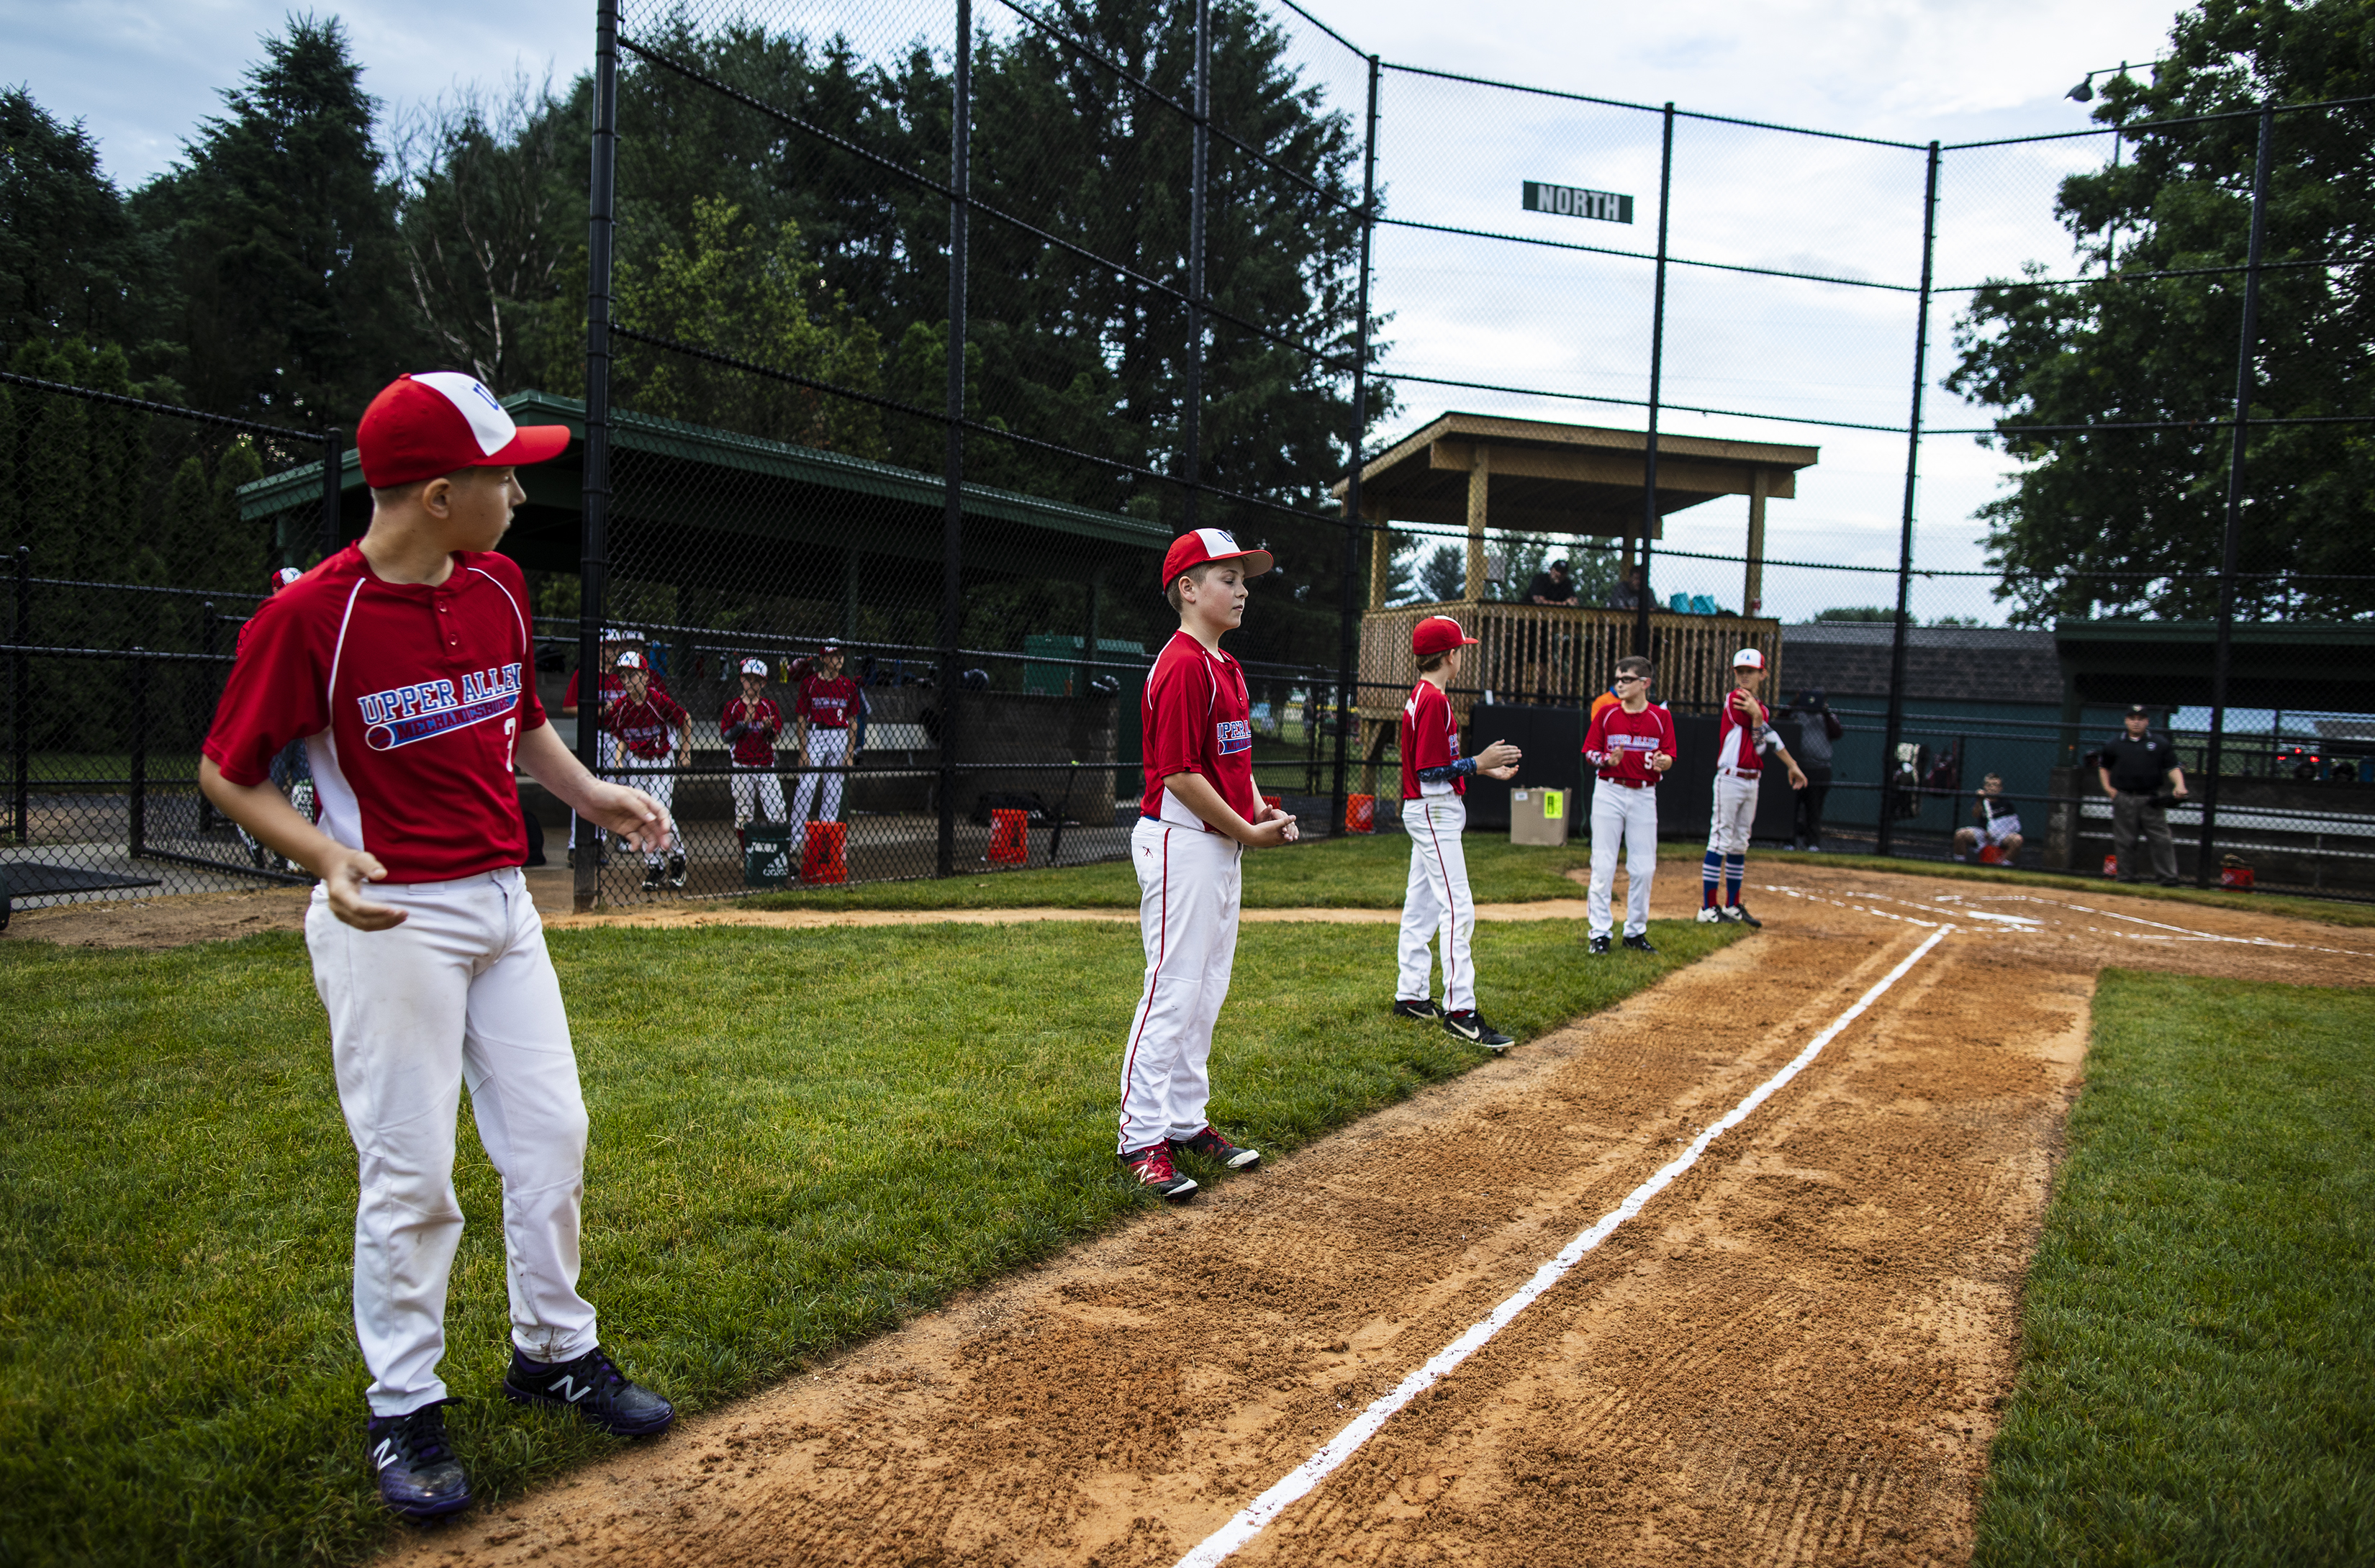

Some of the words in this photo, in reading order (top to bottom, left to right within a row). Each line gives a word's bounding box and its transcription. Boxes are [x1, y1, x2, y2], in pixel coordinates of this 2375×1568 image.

[1537, 184, 1620, 221] NORTH
[357, 679, 458, 725] UPPER
[1644, 751, 1654, 770] 5
[548, 1374, 592, 1402] N
